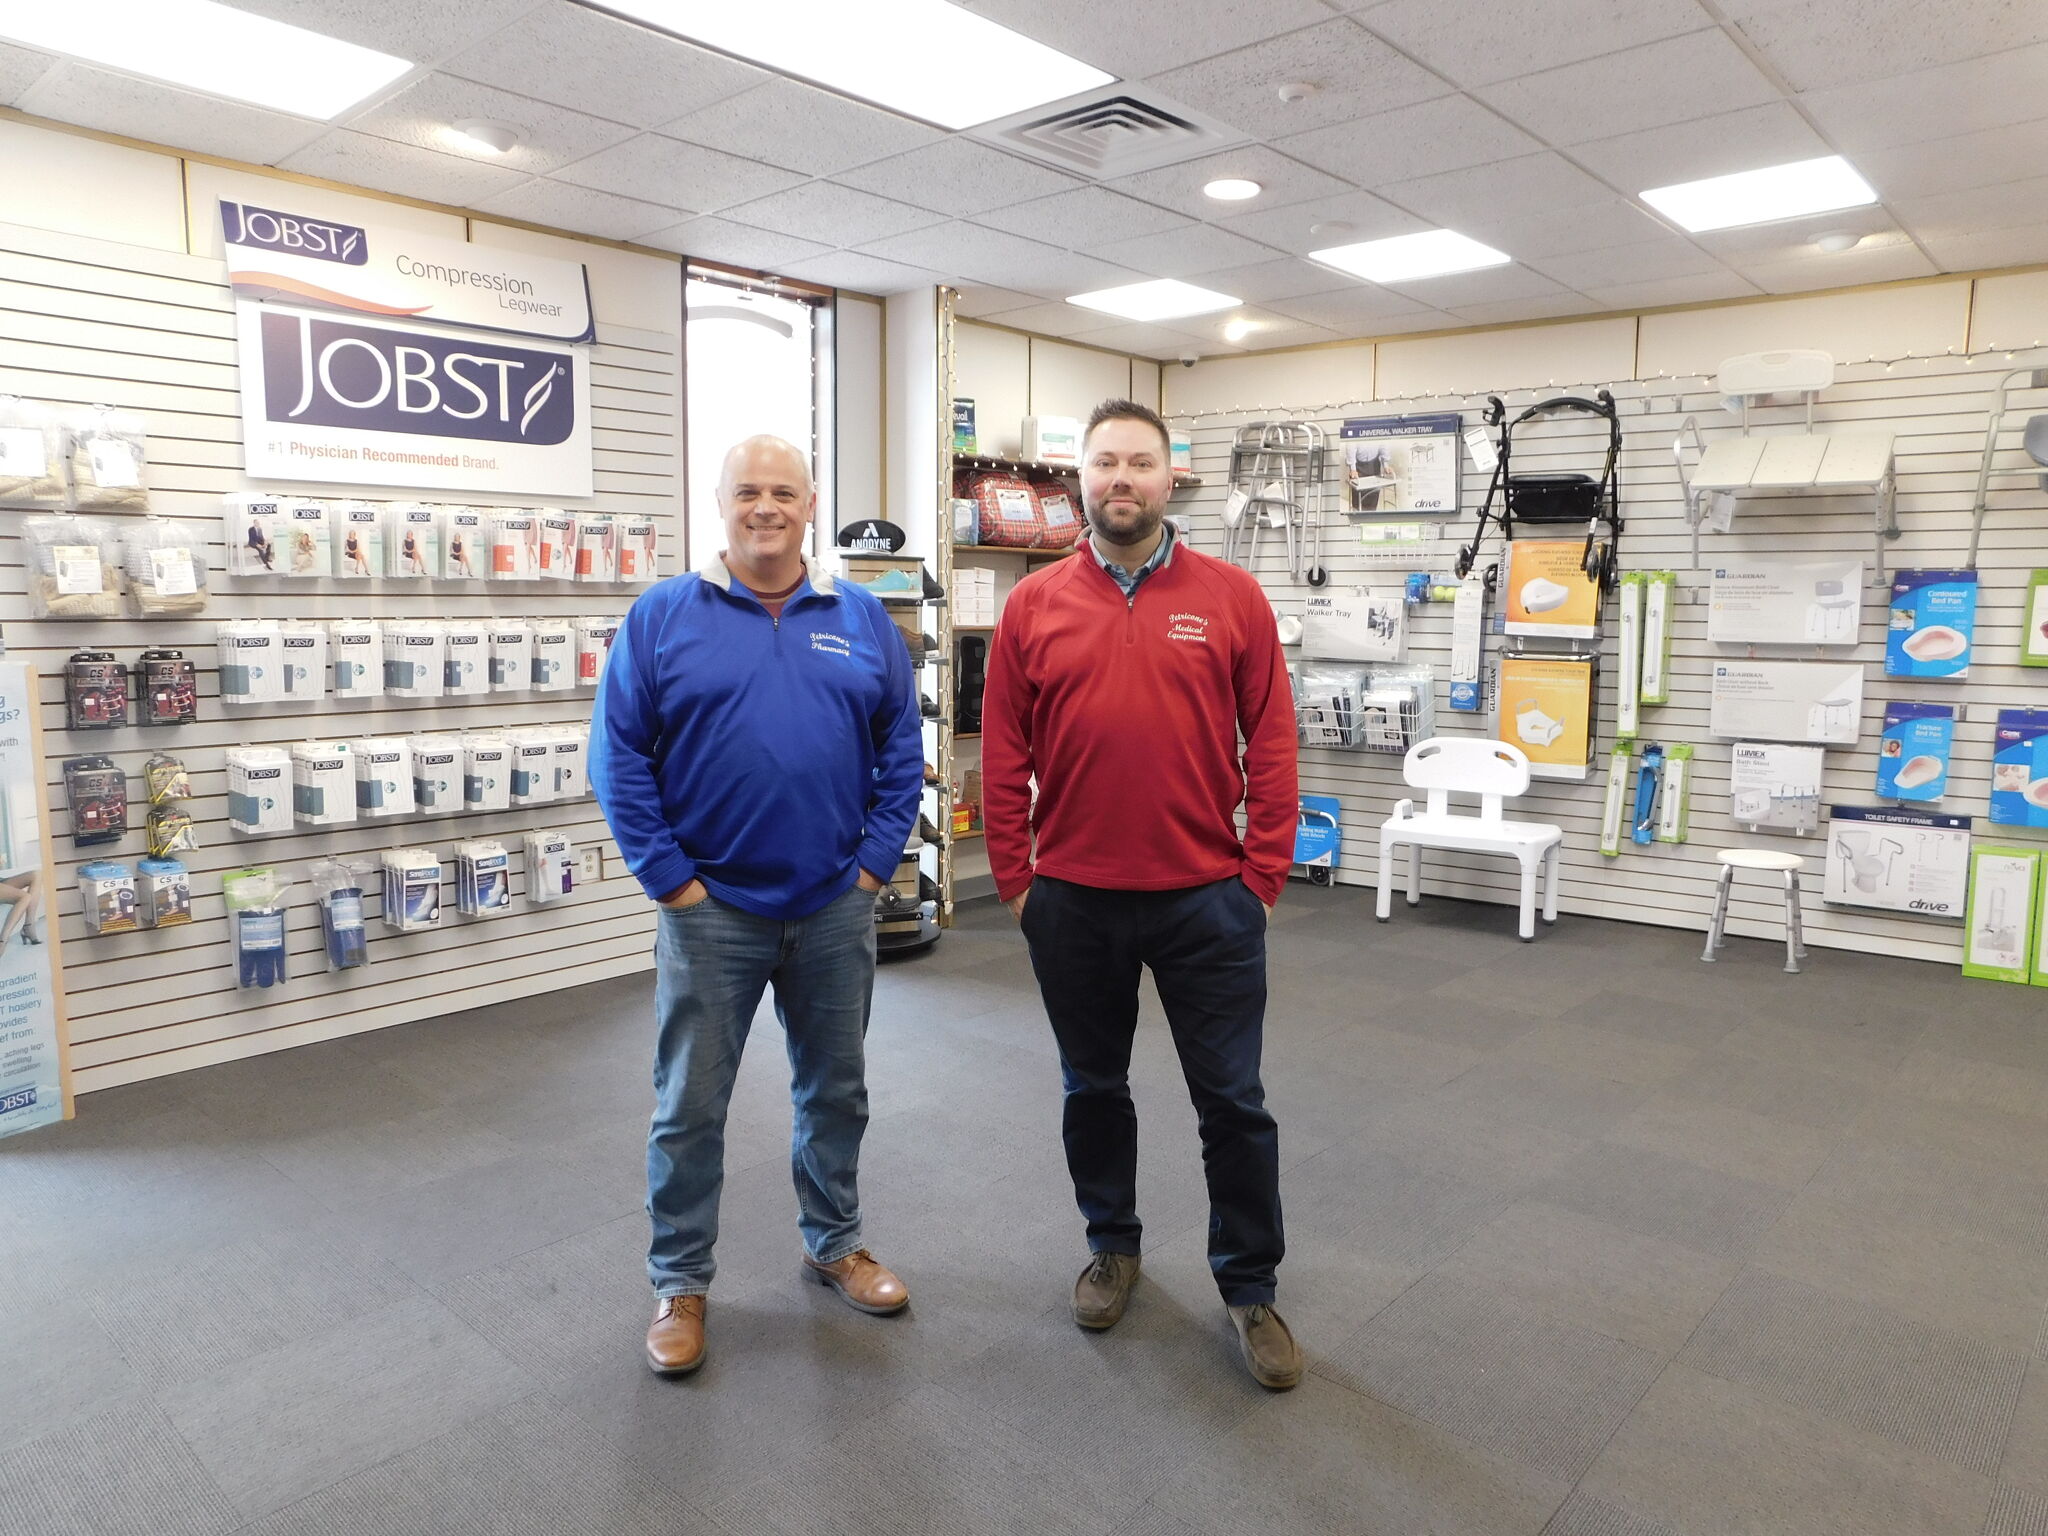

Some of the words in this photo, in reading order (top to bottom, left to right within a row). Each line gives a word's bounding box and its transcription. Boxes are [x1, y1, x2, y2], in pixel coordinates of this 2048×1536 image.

[235, 203, 342, 255] JOBST
[396, 255, 534, 296] Compression
[499, 294, 562, 317] Legwear
[288, 314, 524, 422] JOBST
[1359, 428, 1392, 437] UNIVERSAL
[1392, 427, 1417, 435] WALKER
[267, 441, 284, 454] #1
[289, 441, 358, 460] Physician
[362, 447, 459, 468] Recommended
[462, 455, 500, 471] Brand.
[1414, 499, 1441, 509] drive
[850, 538, 891, 550] ANODYNE
[1498, 547, 1507, 588] GUARDIAN
[1307, 598, 1332, 606] LUMEX
[1307, 608, 1332, 616] Walker
[1335, 610, 1352, 618] Tray
[1172, 624, 1204, 634] Medical
[342, 636, 367, 644] JOBST
[406, 636, 430, 646] JOBST
[452, 636, 475, 644] JOBST
[498, 635, 519, 644] JOBST
[1168, 630, 1206, 642] Equipment
[238, 638, 265, 648] JOBST
[285, 638, 311, 648] JOBST
[811, 642, 850, 656] Pharmacy
[1489, 667, 1497, 712] GUARDIAN
[476, 752, 499, 762] JOBST
[522, 748, 544, 756] JOBST
[1737, 750, 1766, 758] LUMEX
[371, 754, 396, 763] JOBST
[426, 756, 450, 765] JOBST
[313, 762, 340, 770] JOBST
[249, 770, 276, 780] JOBST
[1864, 813, 1886, 821] TOILET
[1886, 815, 1911, 824] SAFETY
[1911, 817, 1933, 826] FRAME
[1909, 898, 1949, 912] drive
[0, 972, 38, 988] gradient
[8, 998, 42, 1013] hosiery
[12, 1028, 34, 1040] from
[30, 1042, 46, 1052] legs
